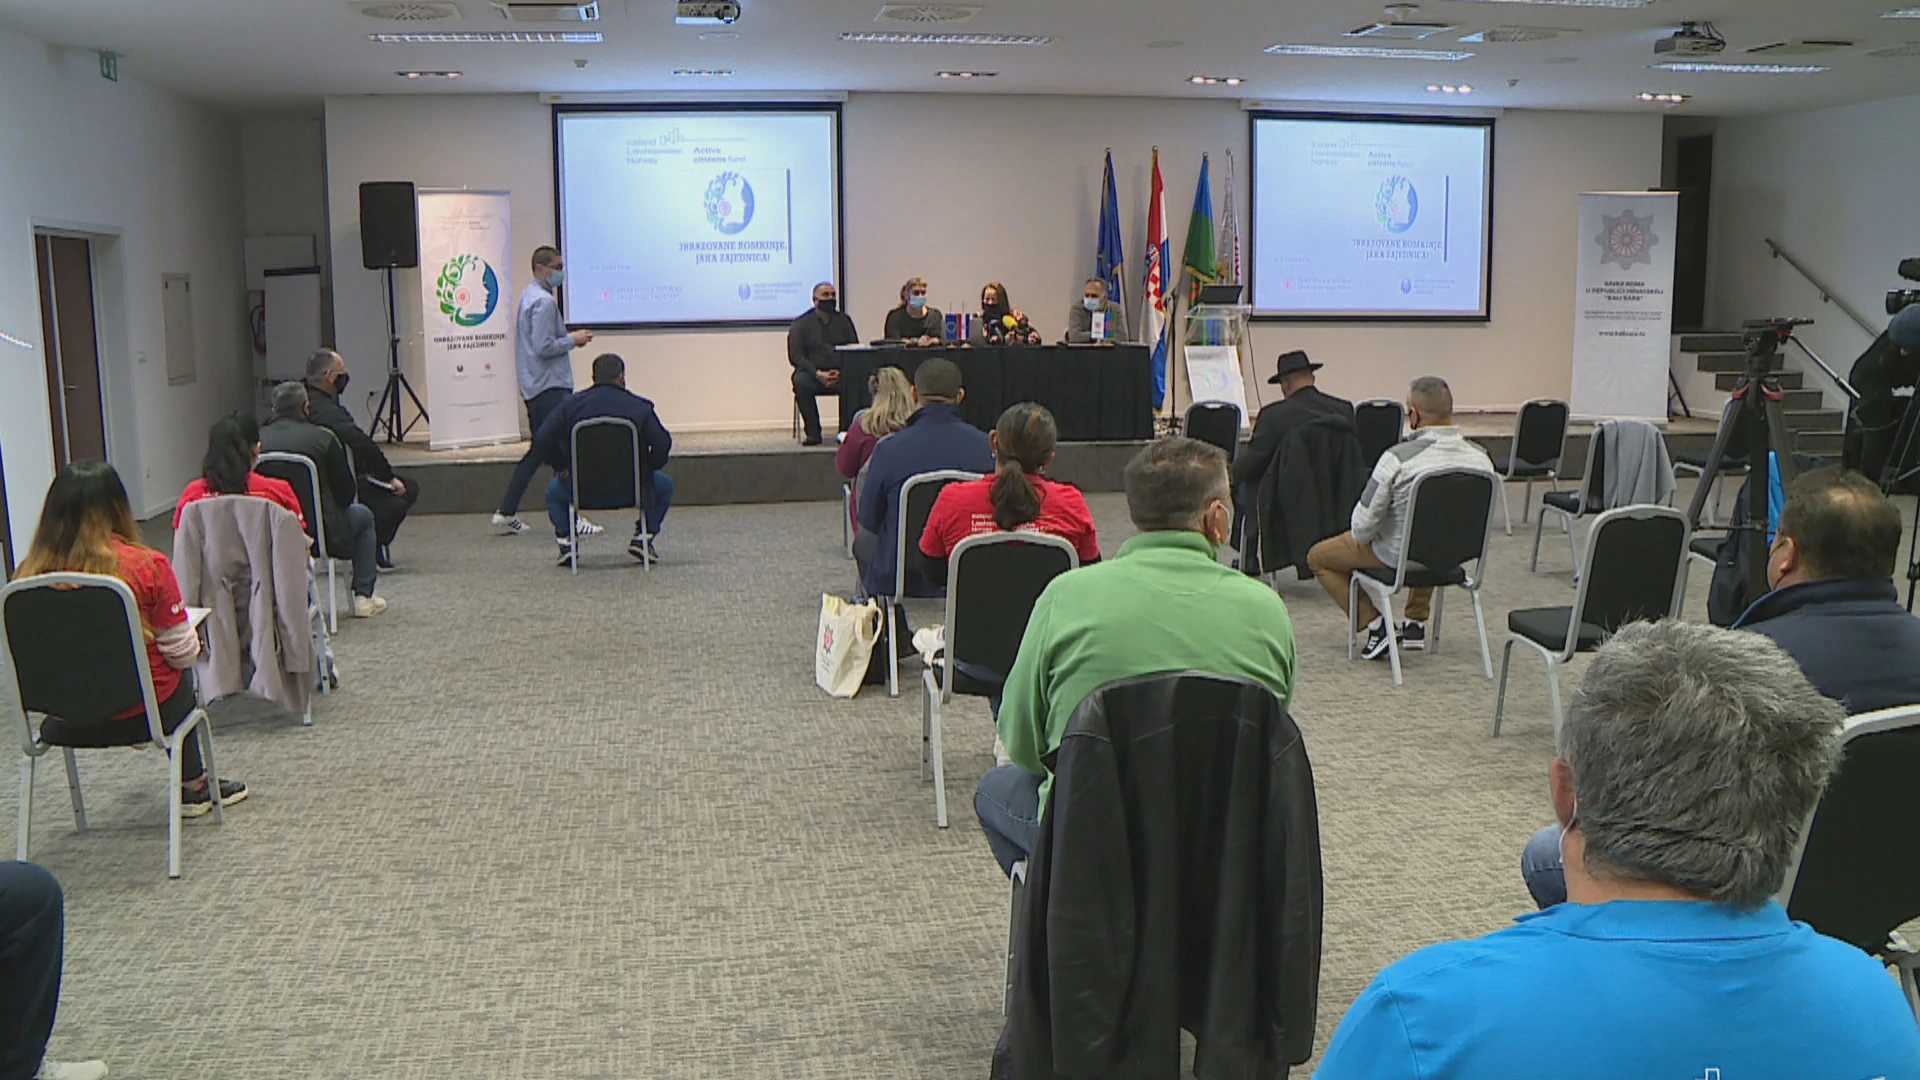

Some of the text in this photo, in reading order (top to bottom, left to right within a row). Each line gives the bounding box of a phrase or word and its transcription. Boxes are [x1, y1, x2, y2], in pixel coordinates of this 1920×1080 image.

[693, 155, 727, 163] citizens
[696, 253, 718, 265] JAKA
[1366, 251, 1384, 260] JAKA
